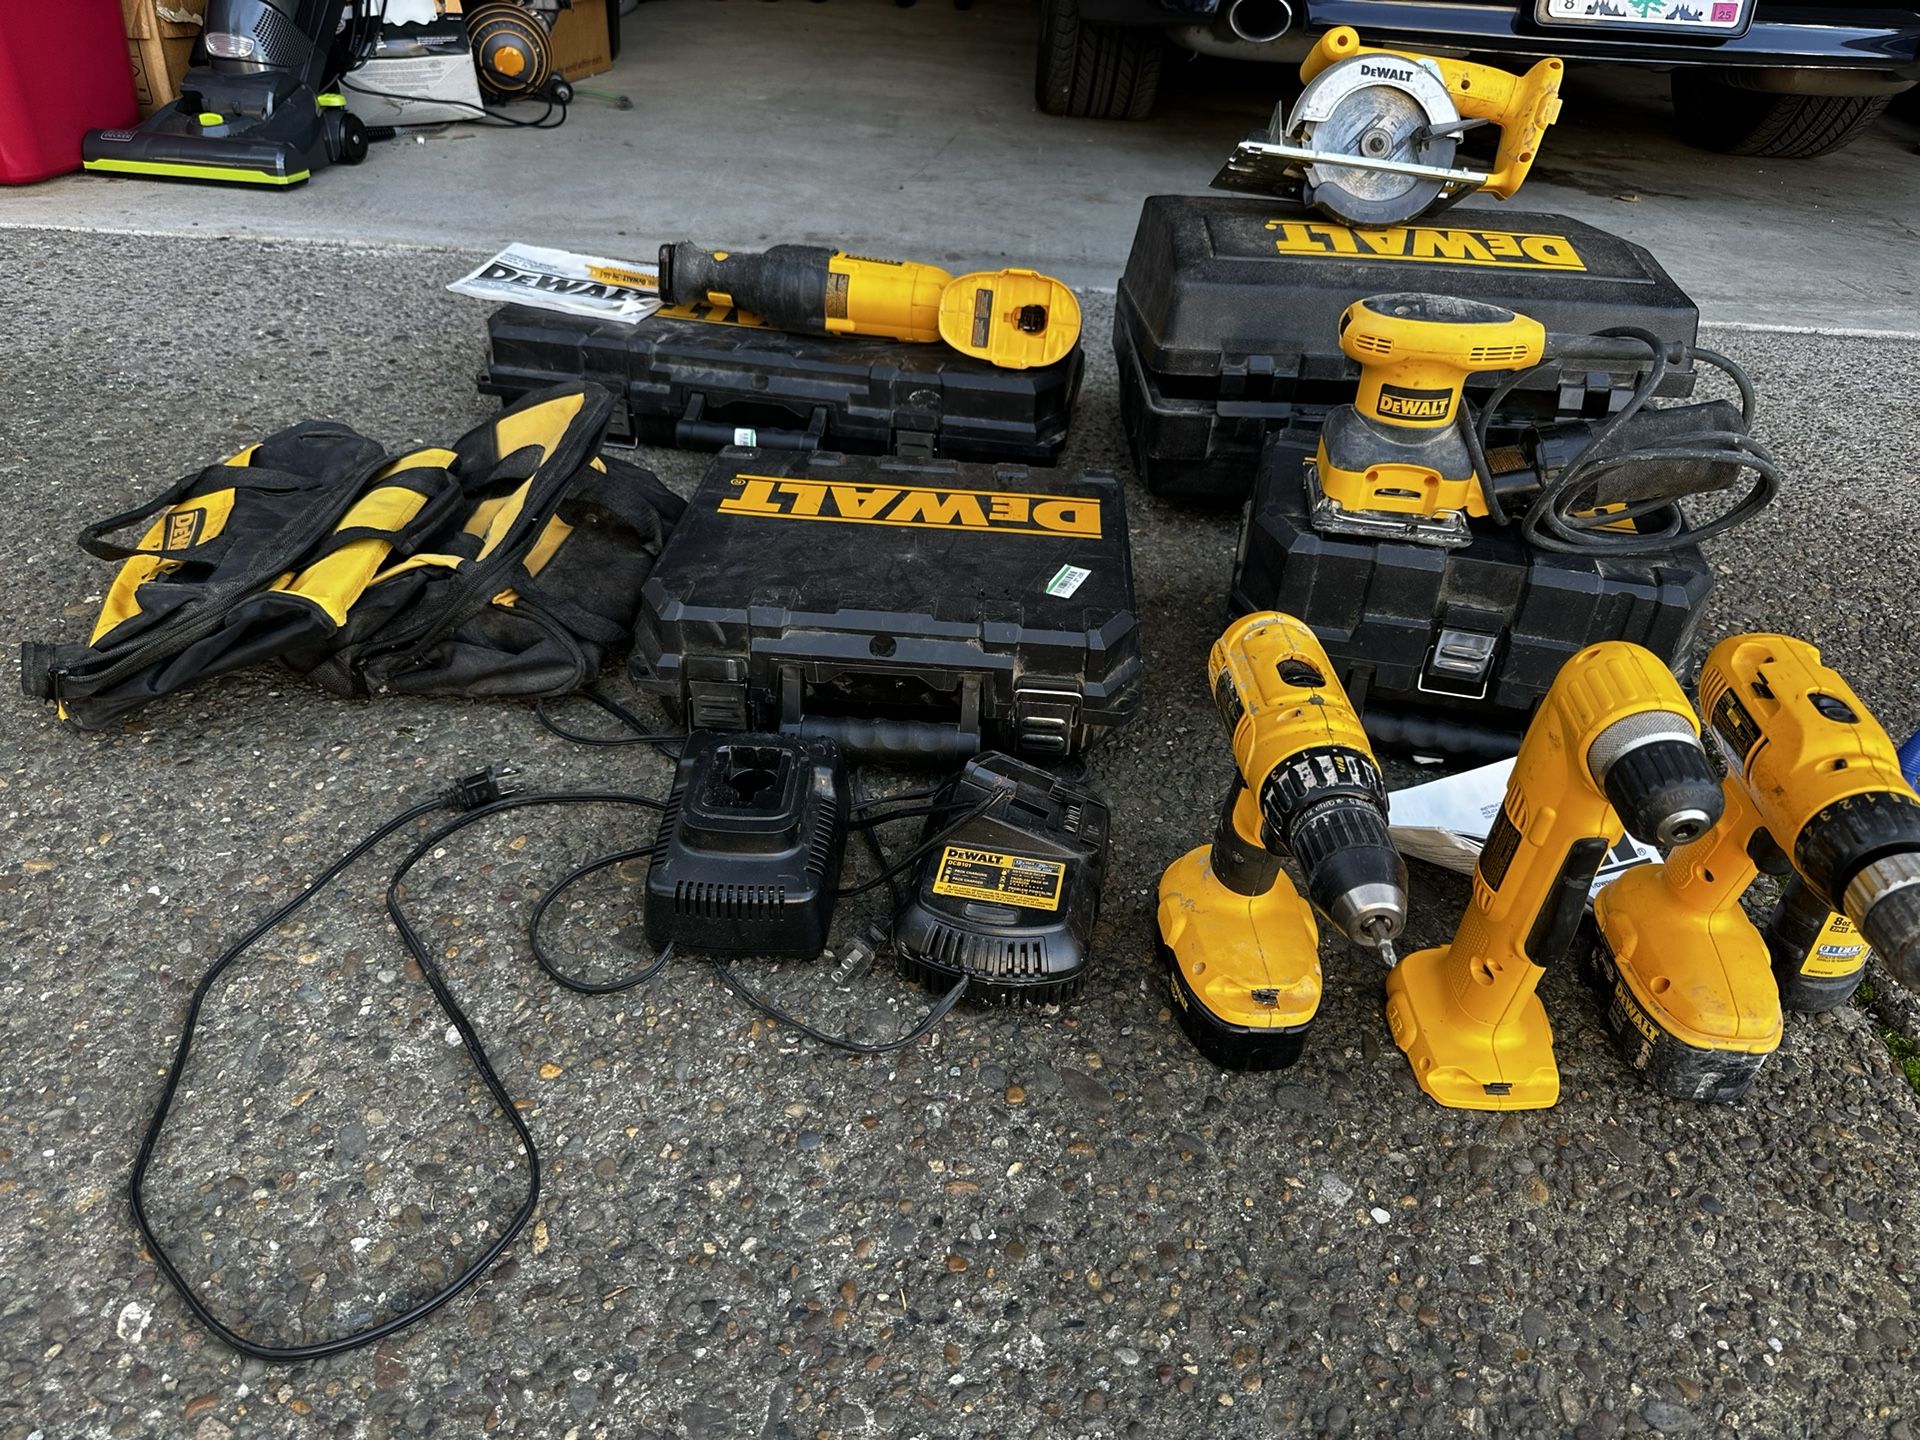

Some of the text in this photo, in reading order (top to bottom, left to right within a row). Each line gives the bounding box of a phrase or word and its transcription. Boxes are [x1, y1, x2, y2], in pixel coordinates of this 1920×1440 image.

[1717, 11, 1732, 20] 25
[1360, 64, 1413, 82] DEWALT
[1276, 223, 1585, 267] DEWALT
[1380, 395, 1449, 415] DEWALT
[720, 479, 1102, 534] DEWALT
[170, 512, 195, 551] DEW
[1820, 810, 1832, 822] 3
[948, 849, 1004, 865] DEWALT
[1615, 980, 1660, 1043] DEWALT
